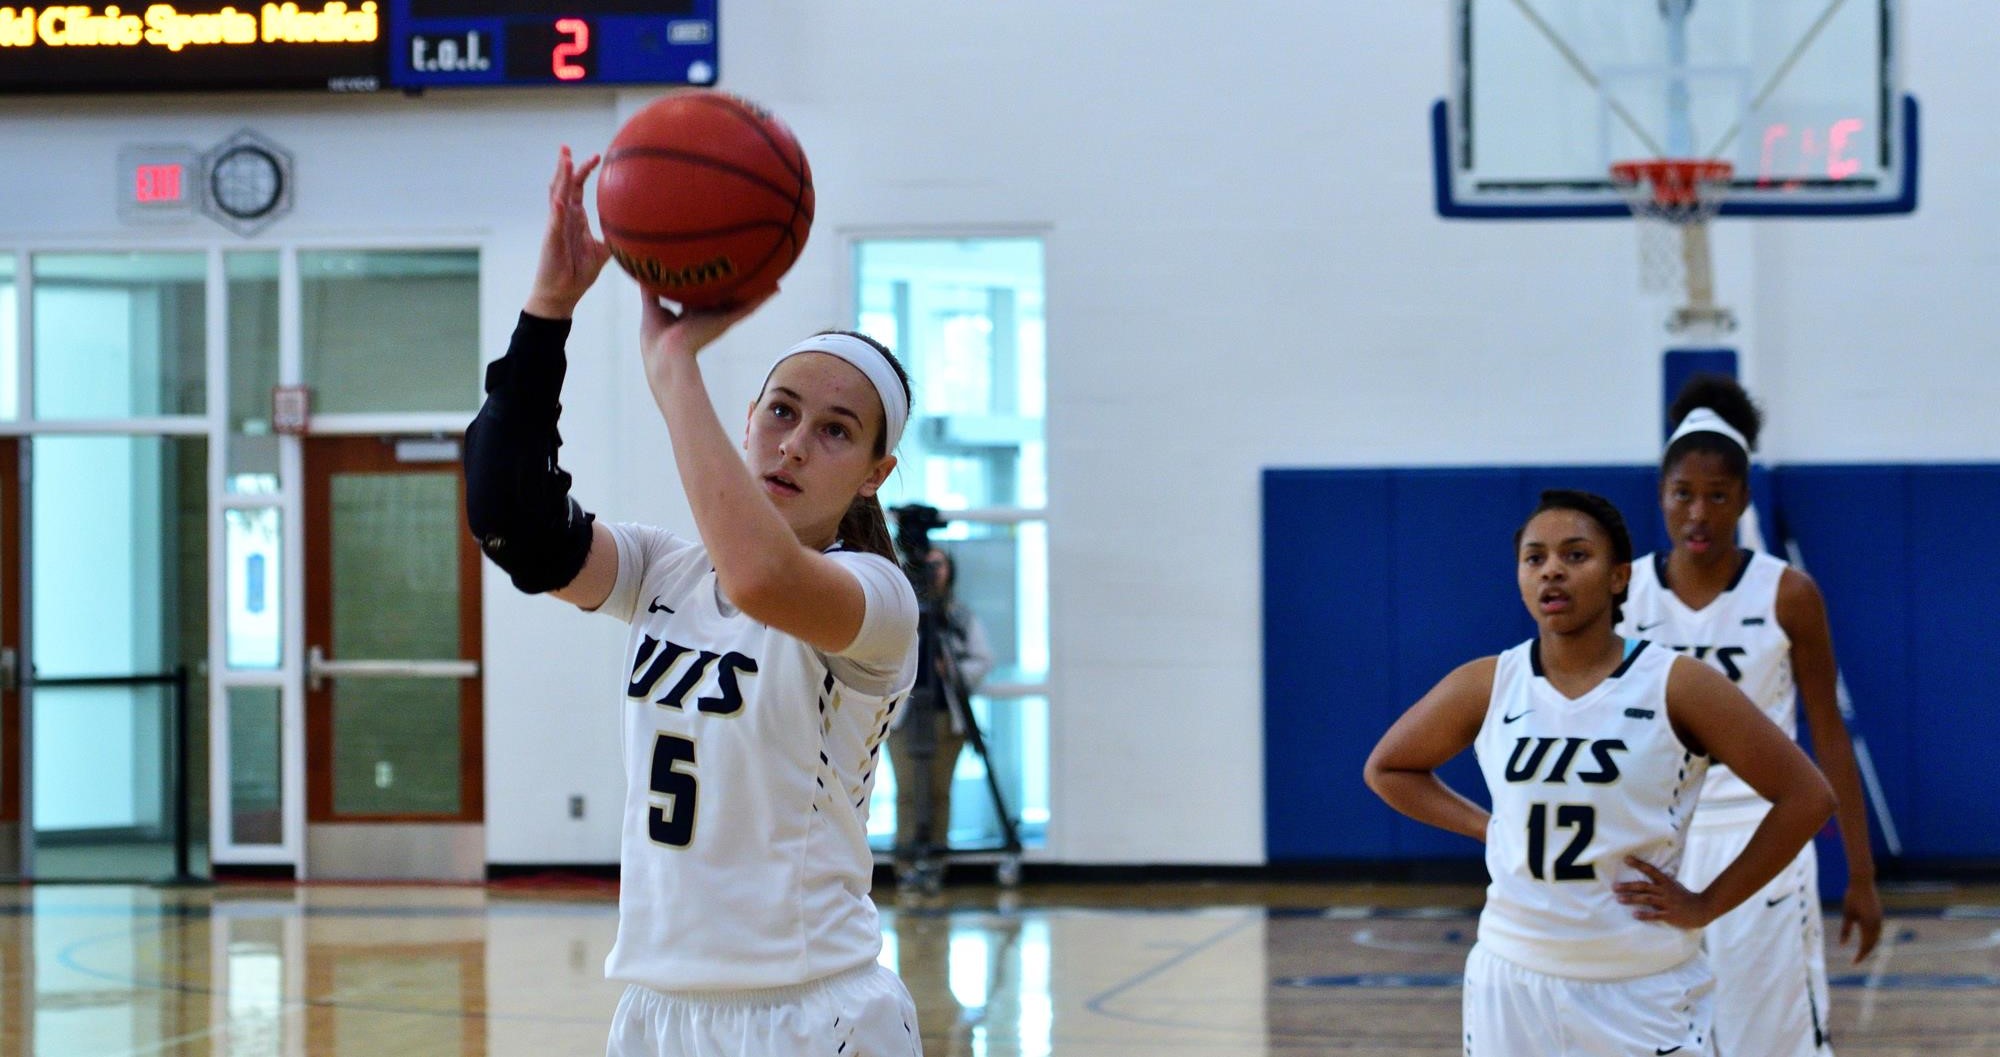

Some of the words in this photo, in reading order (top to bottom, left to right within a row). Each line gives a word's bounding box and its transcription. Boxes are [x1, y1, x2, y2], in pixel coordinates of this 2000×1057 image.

[38, 5, 144, 46] Clinic
[144, 4, 257, 51] Sports
[261, 1, 378, 42] Medici
[412, 30, 490, 71] t.o.l.
[552, 18, 589, 80] 2
[136, 163, 183, 205] EXIT
[627, 634, 759, 719] UIS
[648, 730, 698, 851] 5
[1504, 736, 1629, 786] UIS
[1524, 802, 1598, 882] 12
